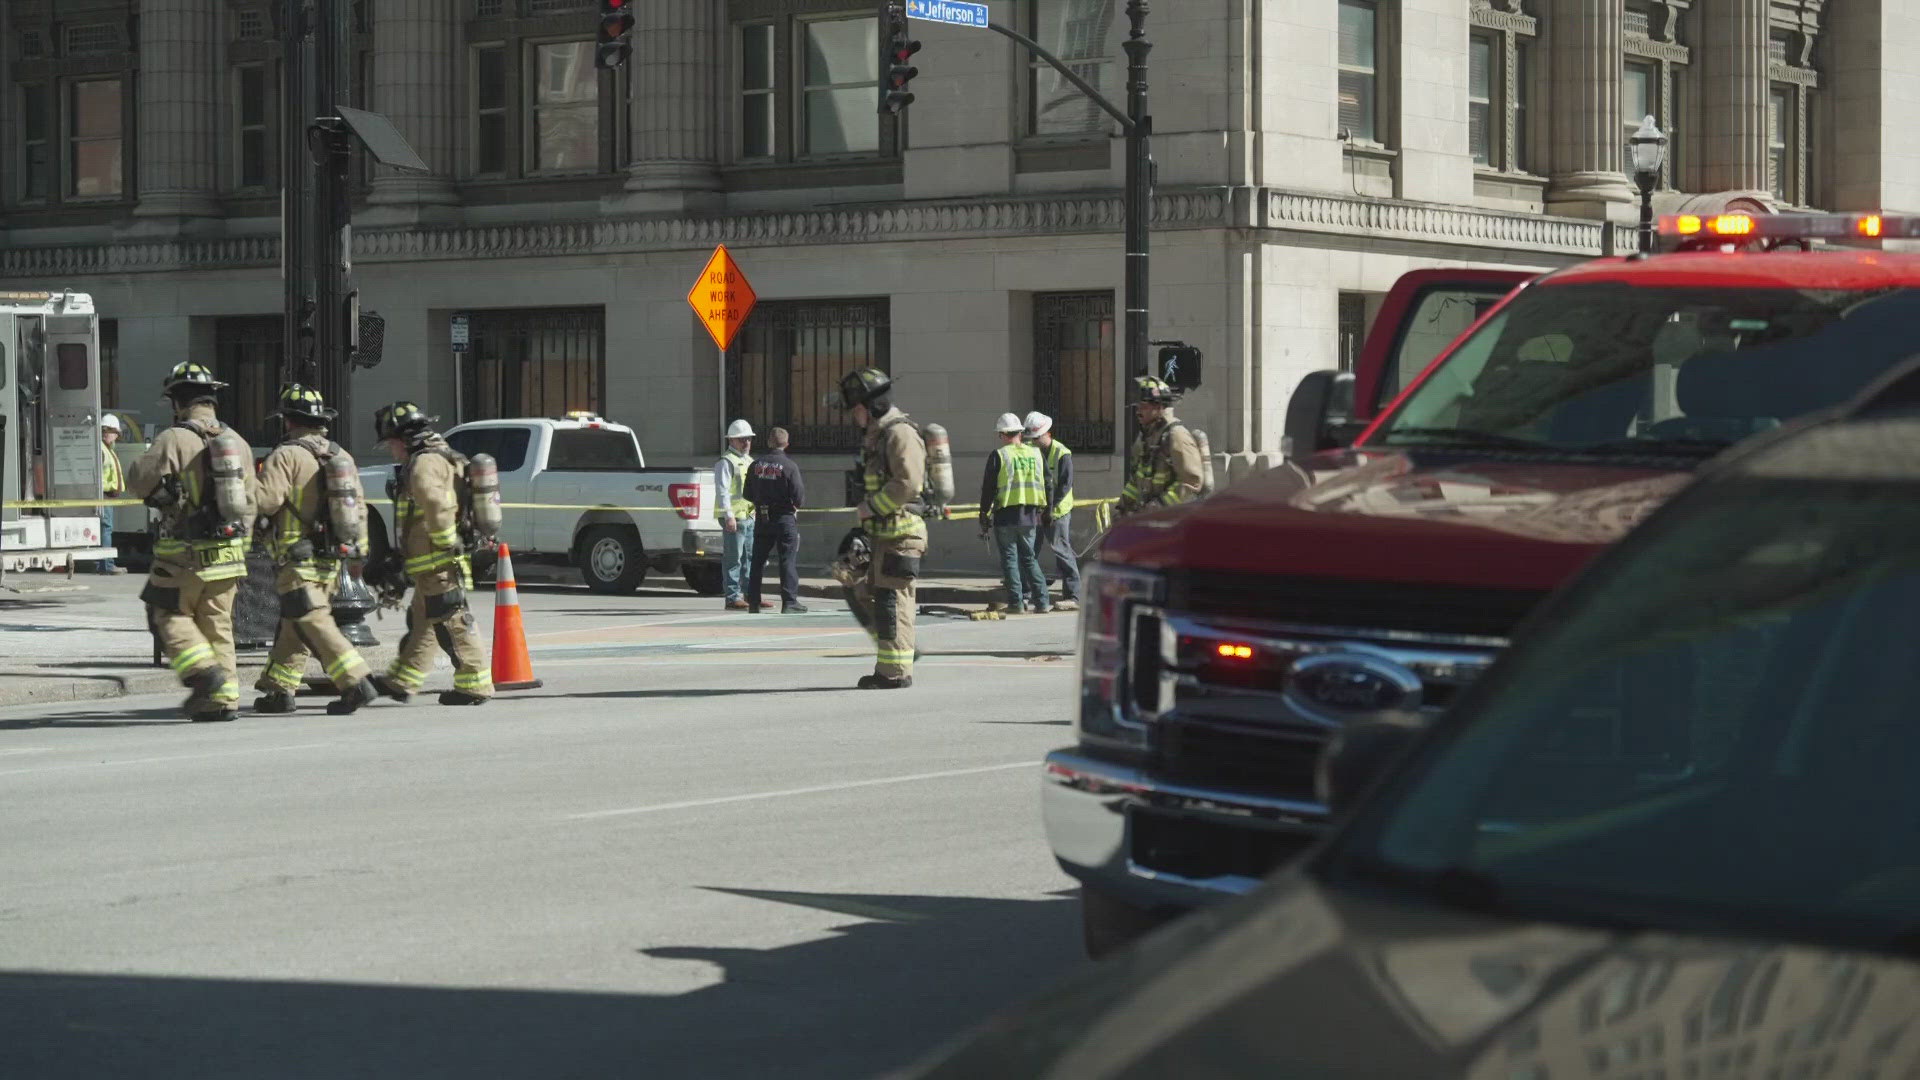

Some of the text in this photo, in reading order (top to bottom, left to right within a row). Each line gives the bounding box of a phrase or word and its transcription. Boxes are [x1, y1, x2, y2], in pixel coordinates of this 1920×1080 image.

[925, 1, 974, 22] Jefferson
[710, 271, 736, 284] ROAD
[710, 291, 736, 302] WORK
[708, 309, 739, 321] AHEAD
